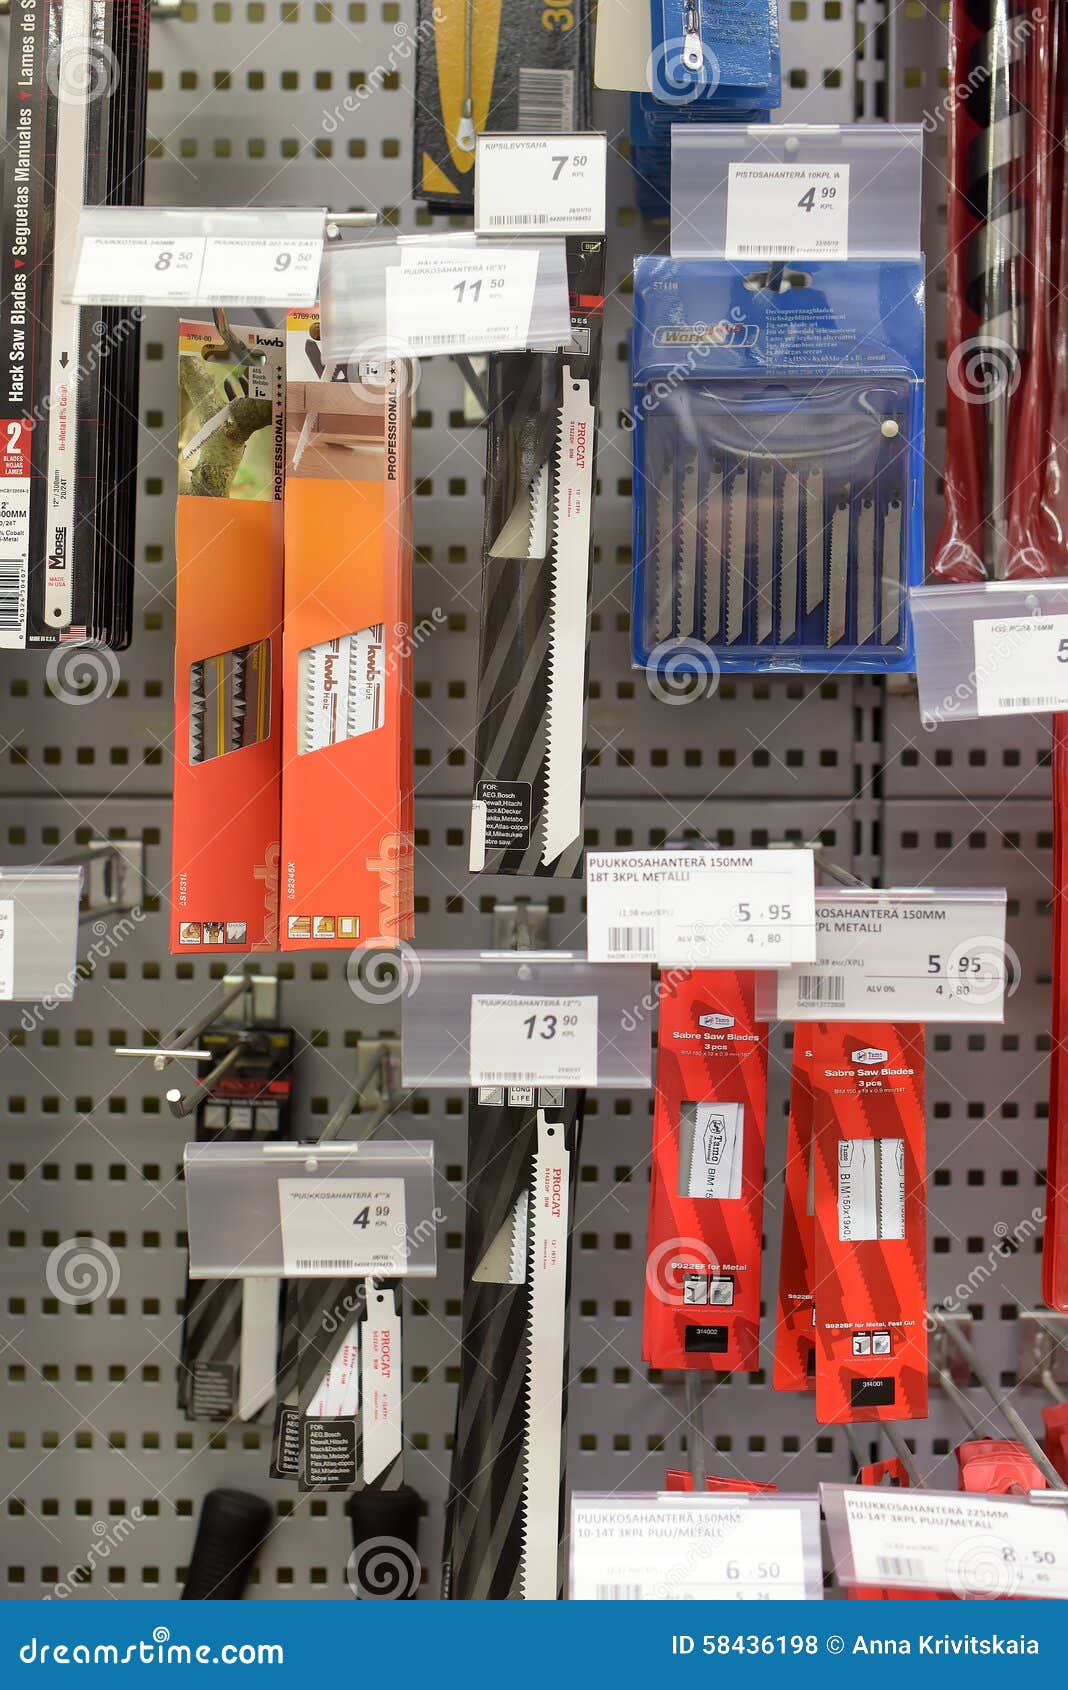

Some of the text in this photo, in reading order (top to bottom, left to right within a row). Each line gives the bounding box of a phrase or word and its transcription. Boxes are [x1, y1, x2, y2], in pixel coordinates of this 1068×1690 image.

[20, 17, 36, 37] de
[18, 39, 34, 87] Lames
[14, 108, 32, 183] Manuales
[484, 142, 548, 150] KIPSILEVYSAHA
[551, 155, 588, 181] 7 50
[735, 171, 807, 179] PISTOSAHANTERÄ
[797, 187, 837, 212] 4 99
[12, 186, 31, 256] Seguetas
[154, 252, 194, 271] 8 50
[273, 253, 313, 272] 9 50
[10, 273, 27, 325] Blades
[453, 278, 505, 303] 11 50
[9, 329, 25, 361] Saw
[256, 334, 284, 348] kwb
[8, 365, 24, 402] Hack
[7, 422, 22, 453] 2
[387, 388, 398, 481] PROFESSIONAL
[577, 422, 586, 469] PROCAT
[274, 412, 284, 501] PROFESSIONAL
[48, 526, 67, 570] MORSE
[322, 654, 339, 711] kwb Holz
[365, 644, 382, 701] kwb Holz
[589, 856, 753, 868] PUUKKOSAHANTERÄ 150MM
[590, 871, 690, 882] 18T 3KPL METALLI
[902, 909, 946, 920] 150MM
[834, 922, 882, 933] METALLI
[866, 985, 895, 993] ALV 0%
[523, 1014, 578, 1040] 13 90
[672, 1031, 760, 1042] Sabre Saw Blades
[857, 1069, 879, 1077] Saw
[881, 1068, 914, 1076] Blades
[711, 1135, 723, 1162] Tamo
[706, 1168, 716, 1186] BIM
[551, 1168, 561, 1218] PROCAT
[352, 1206, 390, 1229] 4 99
[381, 1330, 391, 1378] PROCAT
[577, 1512, 694, 1524] PUUKKOSAHANTERÄ
[848, 1500, 1010, 1519] PUUKKOSAHANTERÄ 225MM
[850, 1511, 887, 1522] 10-14T
[890, 1513, 918, 1524] 3KPL
[577, 1528, 615, 1538] 10-14T
[617, 1528, 645, 1538] 3KPL
